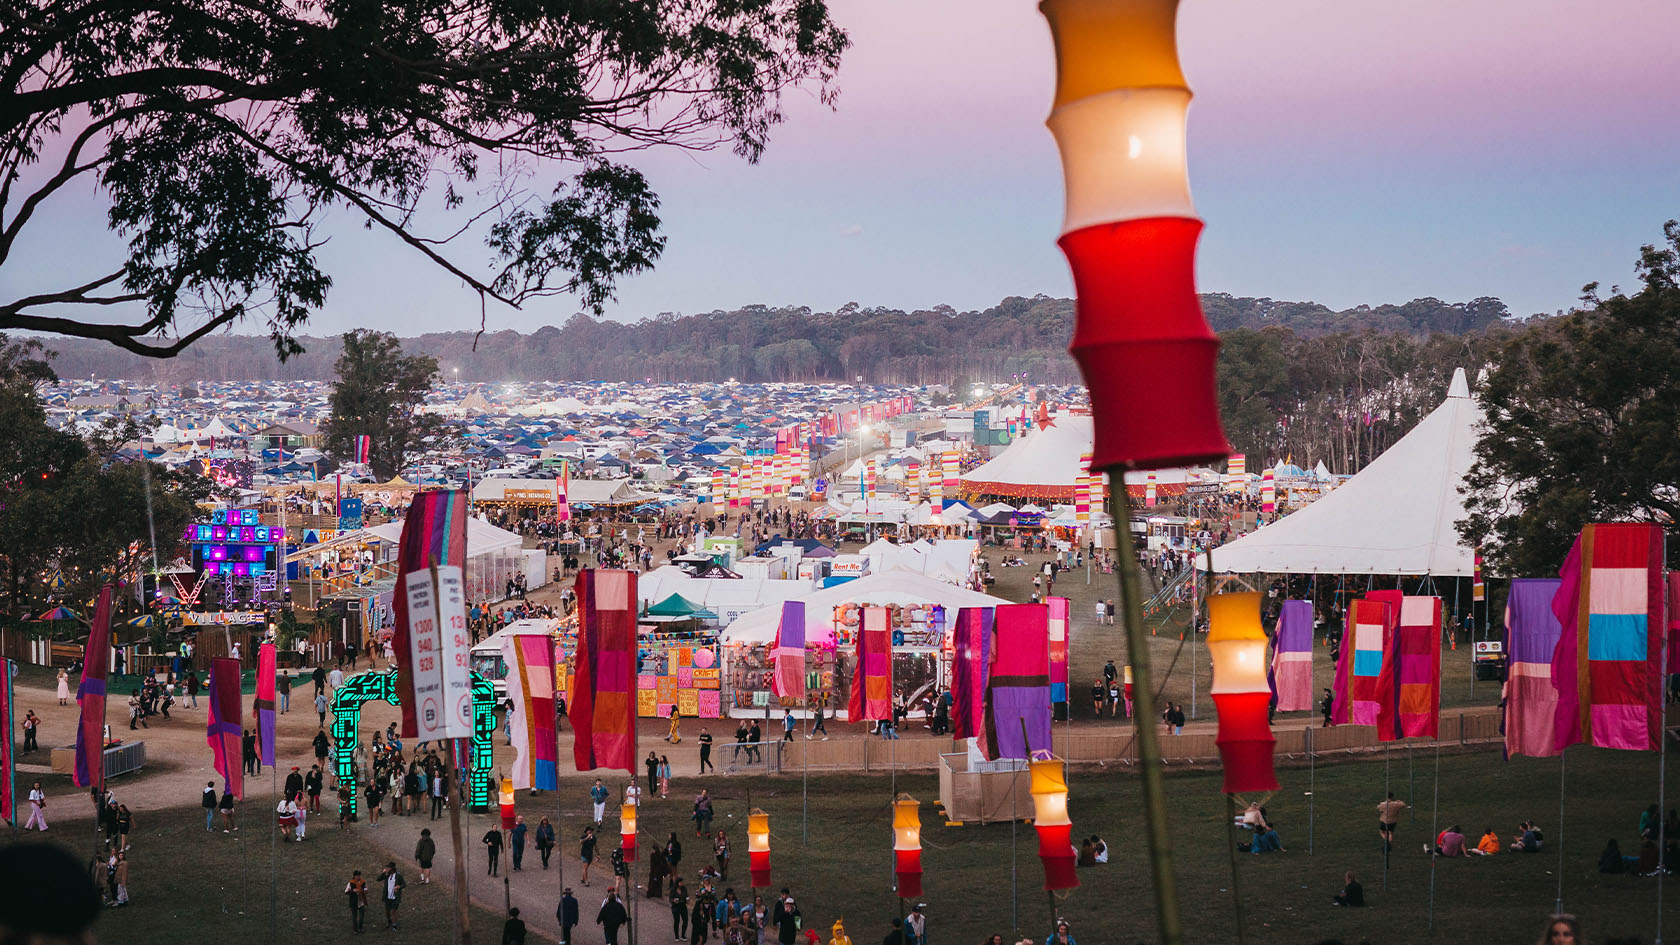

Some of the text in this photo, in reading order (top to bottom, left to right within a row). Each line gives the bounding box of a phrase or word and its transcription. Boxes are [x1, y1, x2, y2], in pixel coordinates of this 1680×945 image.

[213, 510, 253, 524] VIP
[184, 525, 282, 541] VILLAGE
[189, 613, 257, 625] VILLAGE
[366, 604, 388, 633] VIP
[414, 618, 433, 634] 1300
[417, 637, 433, 653] 940
[419, 657, 434, 672] 928
[693, 669, 715, 678] CRAFT
